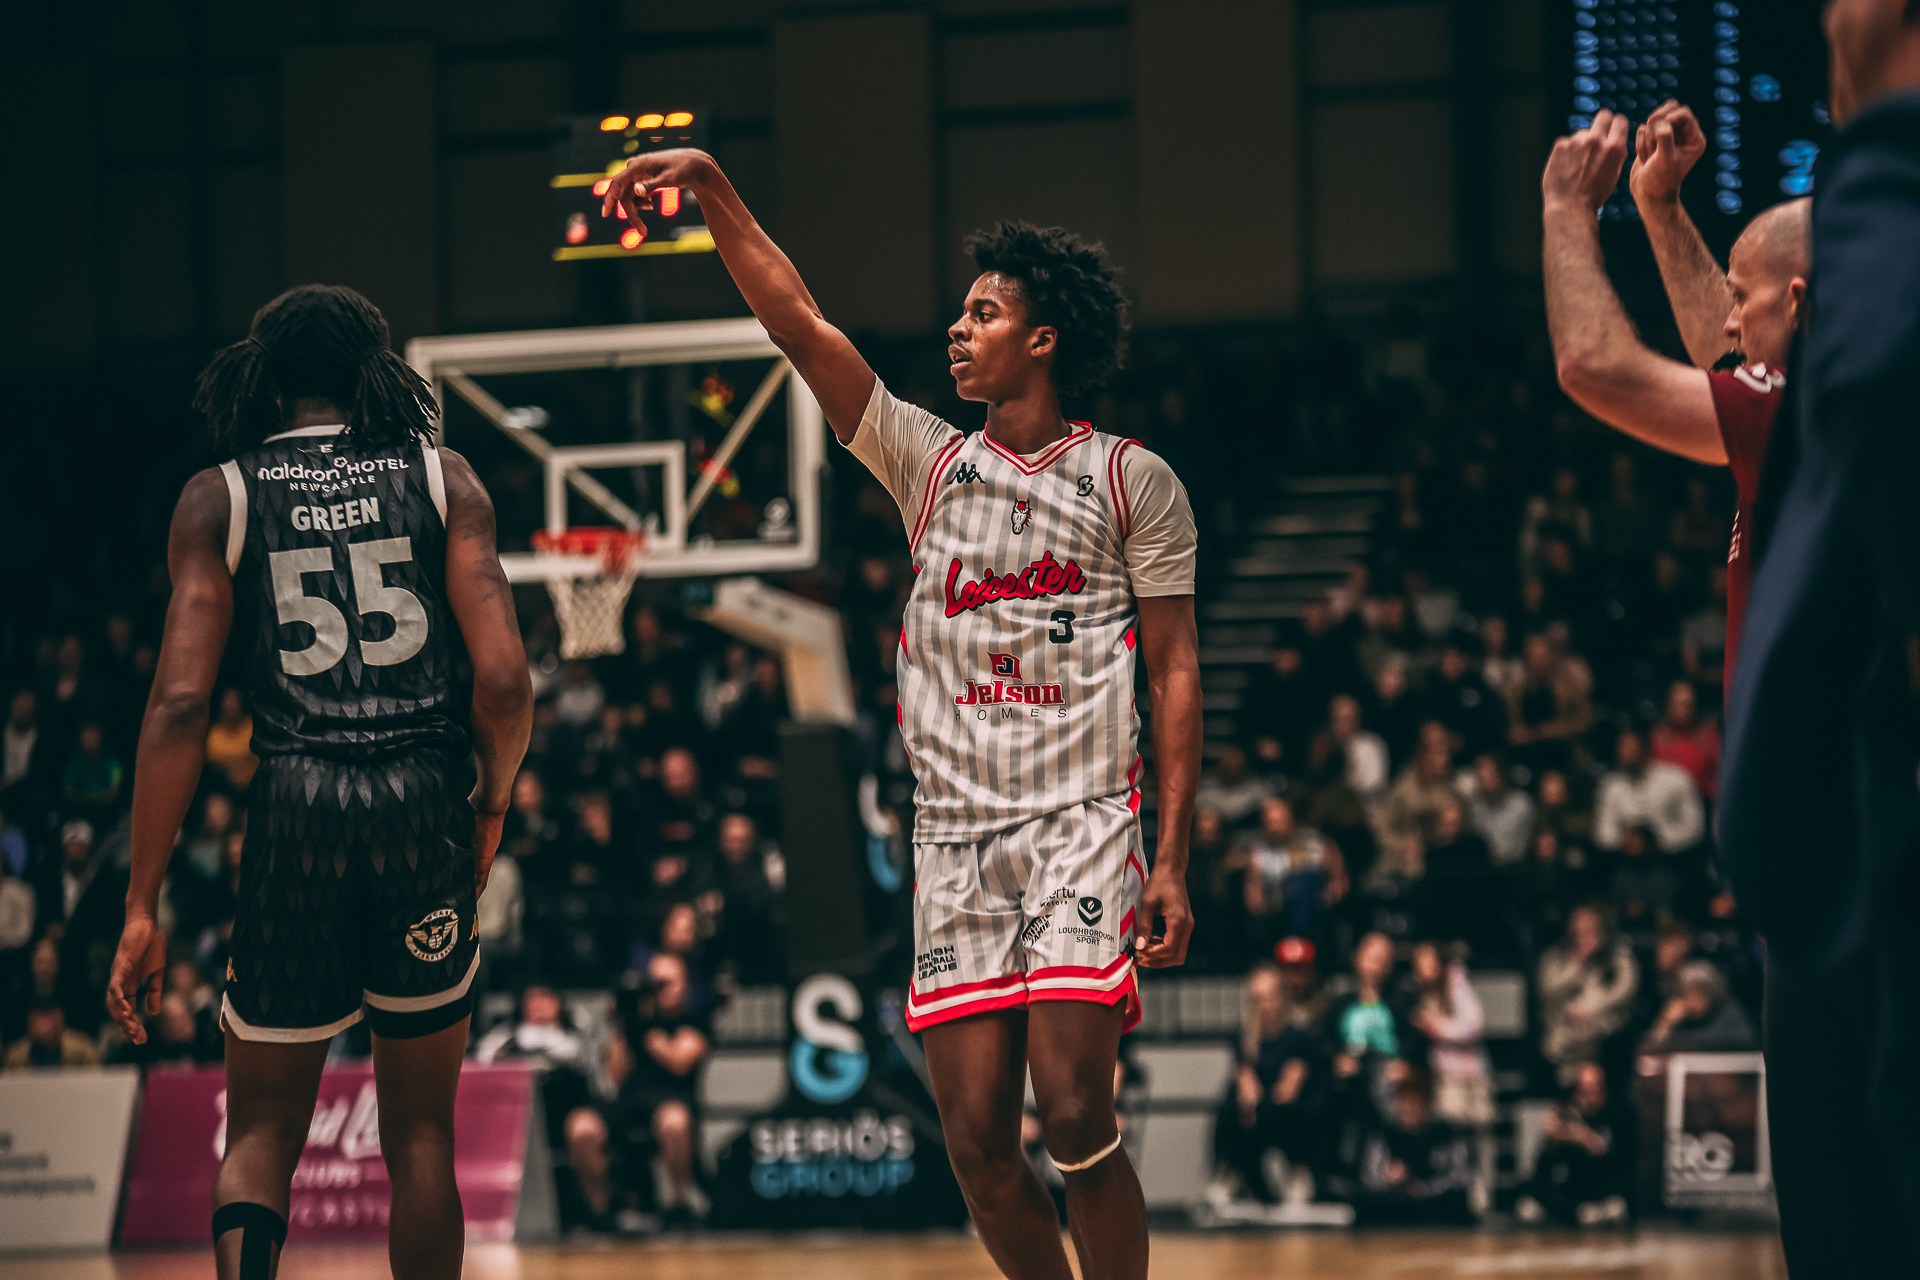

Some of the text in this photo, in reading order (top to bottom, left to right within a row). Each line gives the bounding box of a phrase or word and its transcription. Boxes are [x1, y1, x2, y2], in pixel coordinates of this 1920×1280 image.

[347, 458, 410, 476] HOTEL
[289, 475, 376, 493] NEWCASTLE
[290, 496, 381, 532] GREEN
[945, 550, 1088, 619] Leicester
[268, 536, 429, 676] 55
[1048, 609, 1077, 644] 3
[954, 679, 1067, 707] Jelson
[954, 707, 1068, 721] HOMES
[1042, 886, 1076, 903] ertu
[1058, 927, 1115, 943] LOUGHBOROUGH
[1075, 936, 1101, 946] SPORT
